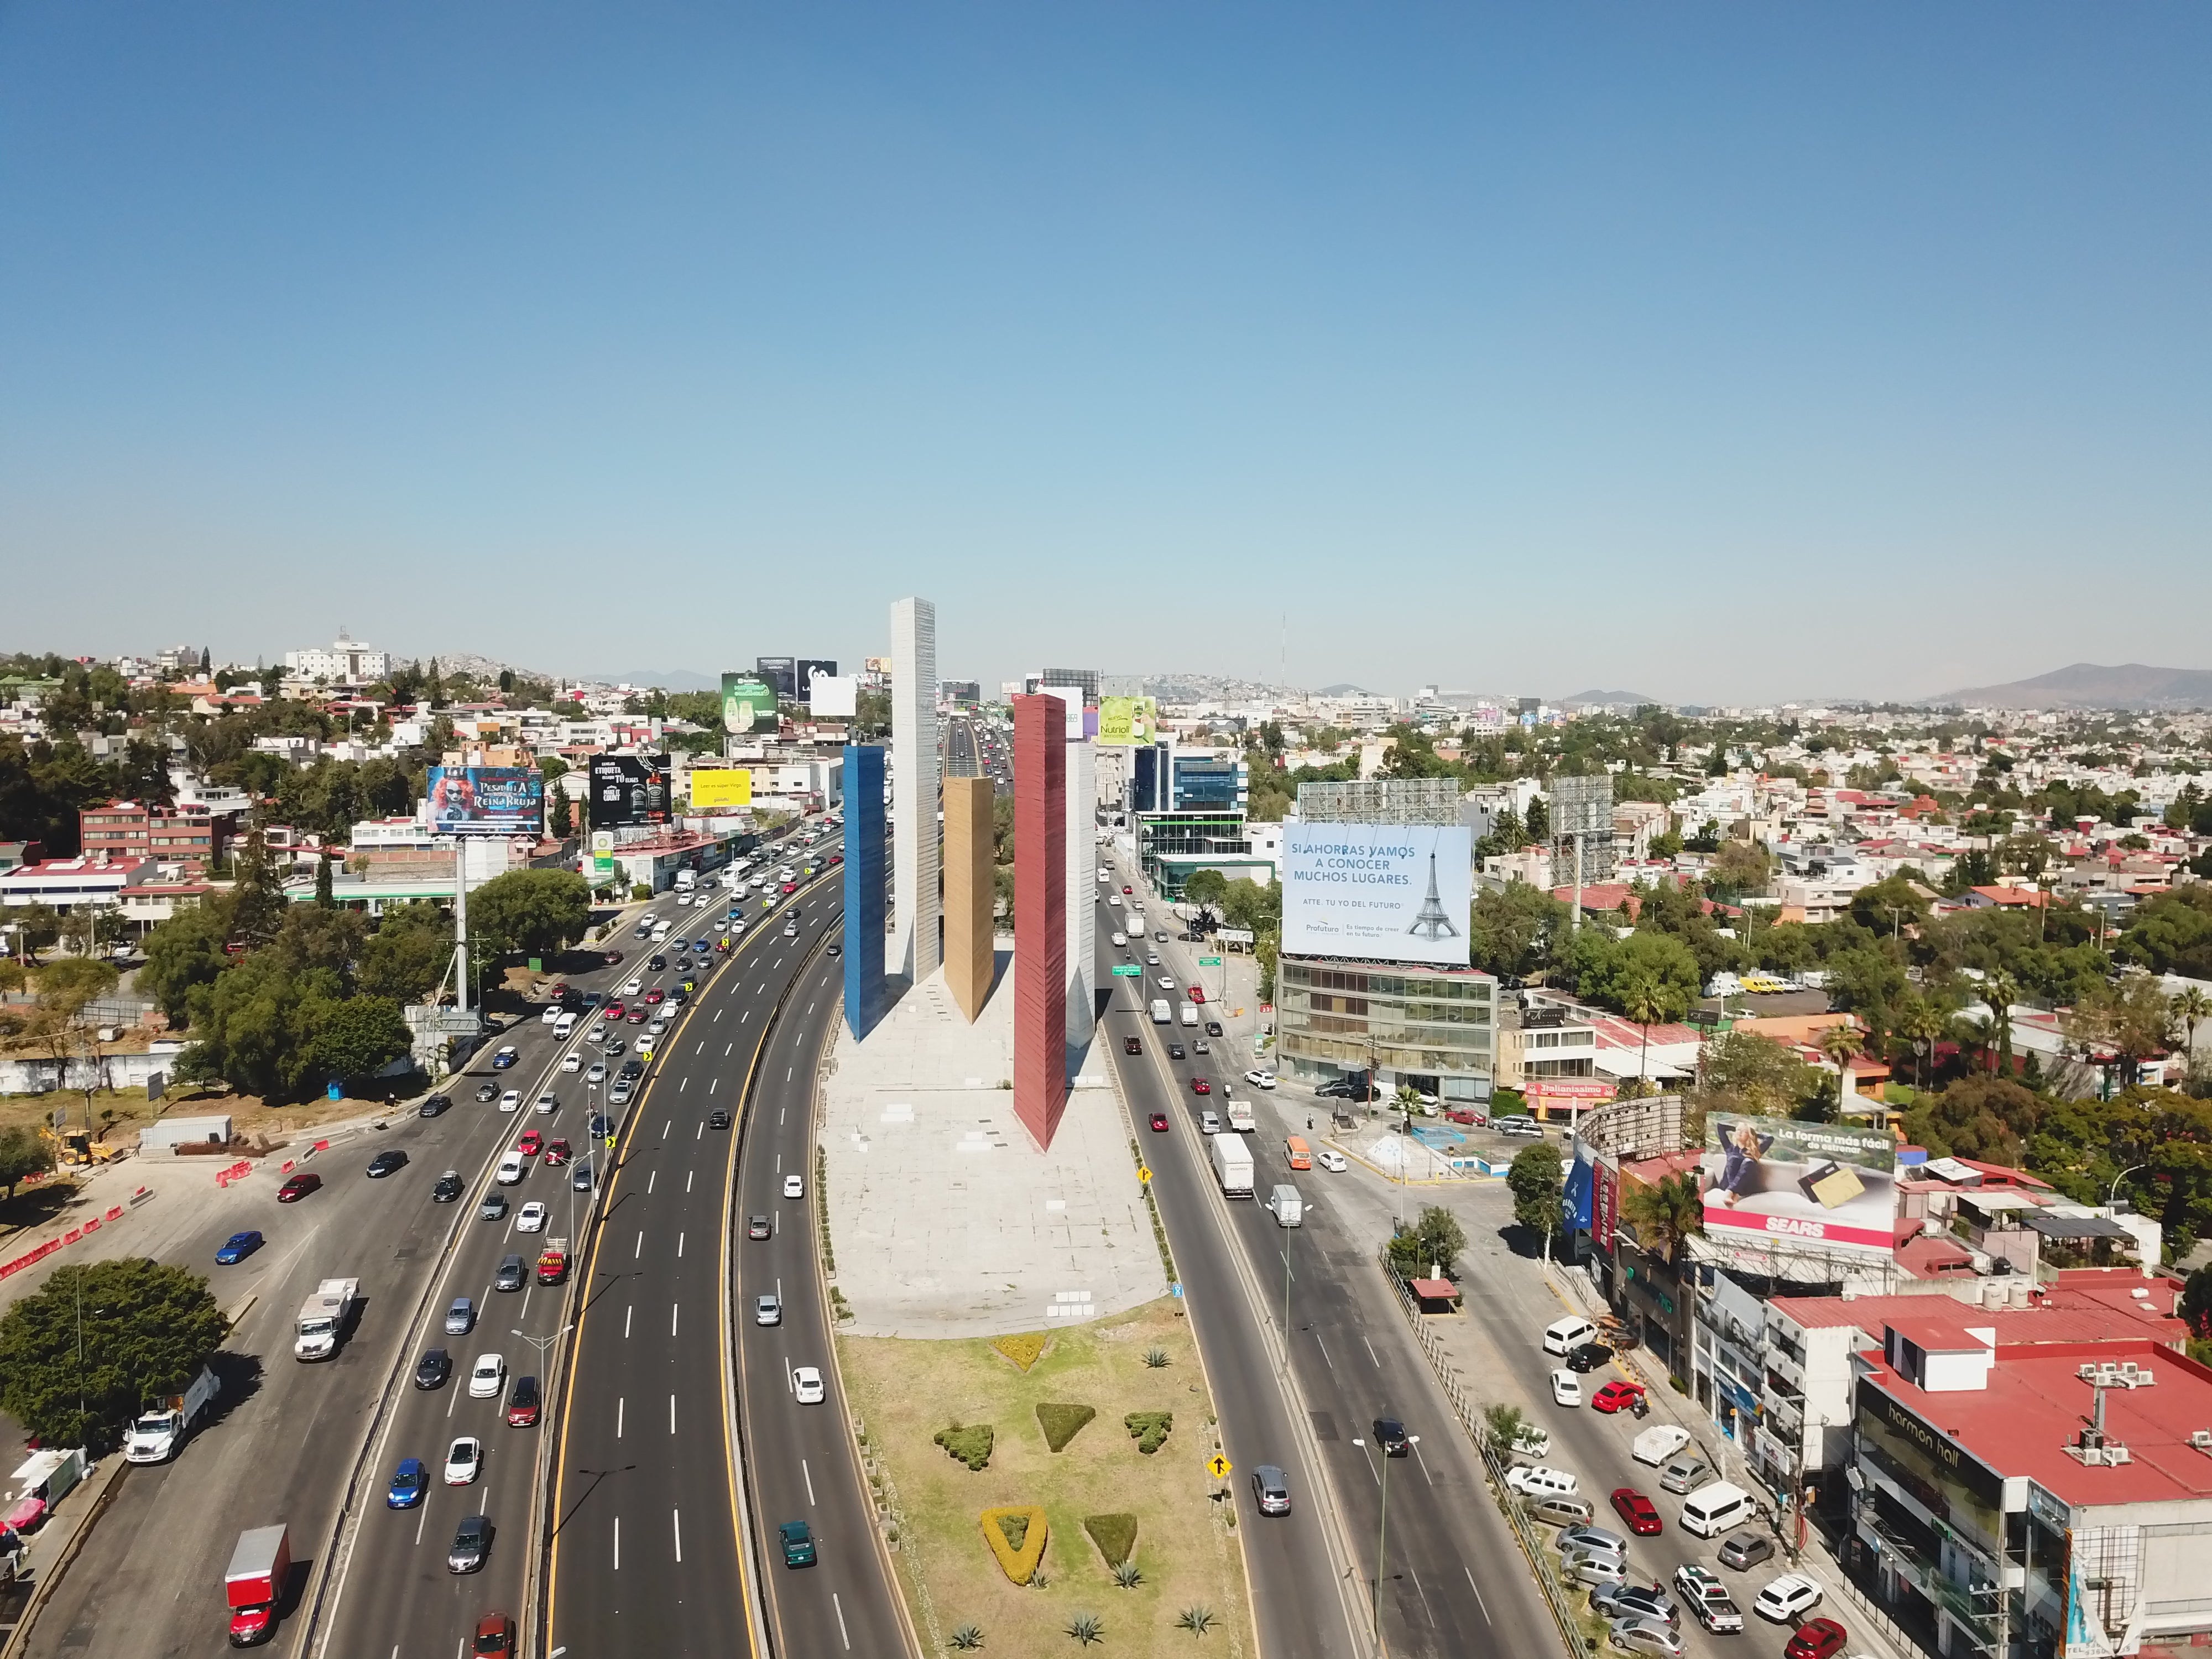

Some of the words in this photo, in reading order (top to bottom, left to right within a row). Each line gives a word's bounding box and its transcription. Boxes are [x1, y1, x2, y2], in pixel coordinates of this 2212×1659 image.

[1291, 843, 1302, 853] SI
[1305, 844, 1365, 855] AHORRAS
[1369, 846, 1415, 858] VAMOS
[1314, 858, 1324, 868] A
[1328, 858, 1390, 870] CONOCER
[1294, 870, 1348, 883] MUCHOS
[1352, 873, 1412, 885] LUGARES.
[1306, 924, 1339, 933] Profuturo
[1541, 1084, 1601, 1093] Italianissimo
[1778, 1128, 1793, 1139] La
[1796, 1130, 1832, 1143] forma
[1834, 1135, 1859, 1147] más
[1861, 1138, 1889, 1150] fácil
[1807, 1141, 1820, 1150] de
[1821, 1144, 1861, 1154] estrenar
[1765, 1217, 1824, 1238] SEARS
[1888, 1402, 1933, 1449] harmon
[1937, 1438, 1958, 1468] hall
